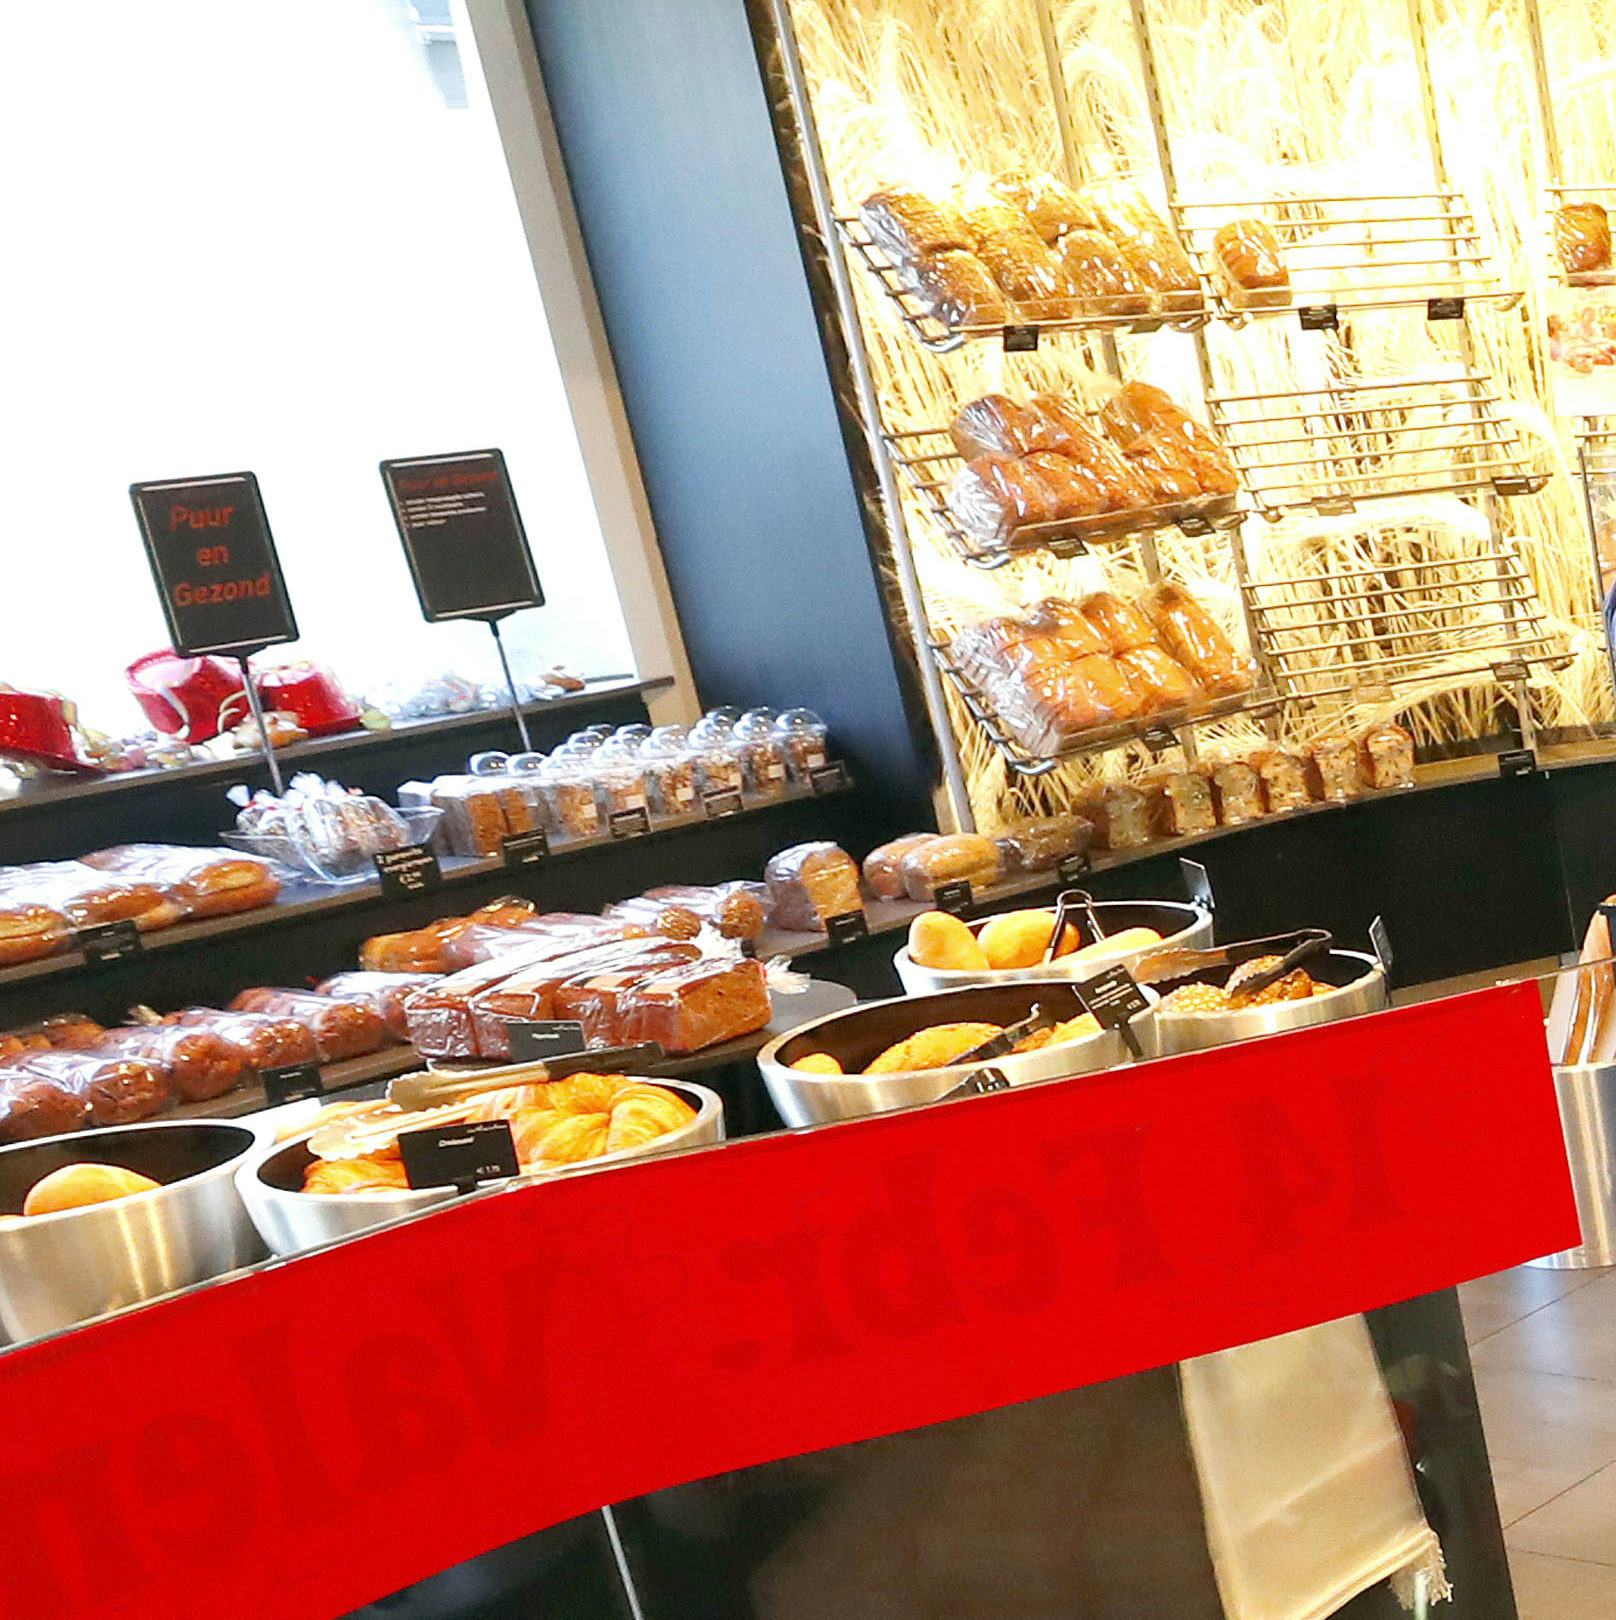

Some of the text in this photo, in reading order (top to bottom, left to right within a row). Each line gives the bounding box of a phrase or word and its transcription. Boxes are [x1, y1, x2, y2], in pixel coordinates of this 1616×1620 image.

[170, 505, 236, 531] Puur
[196, 544, 230, 566] en
[174, 571, 272, 607] Gezond
